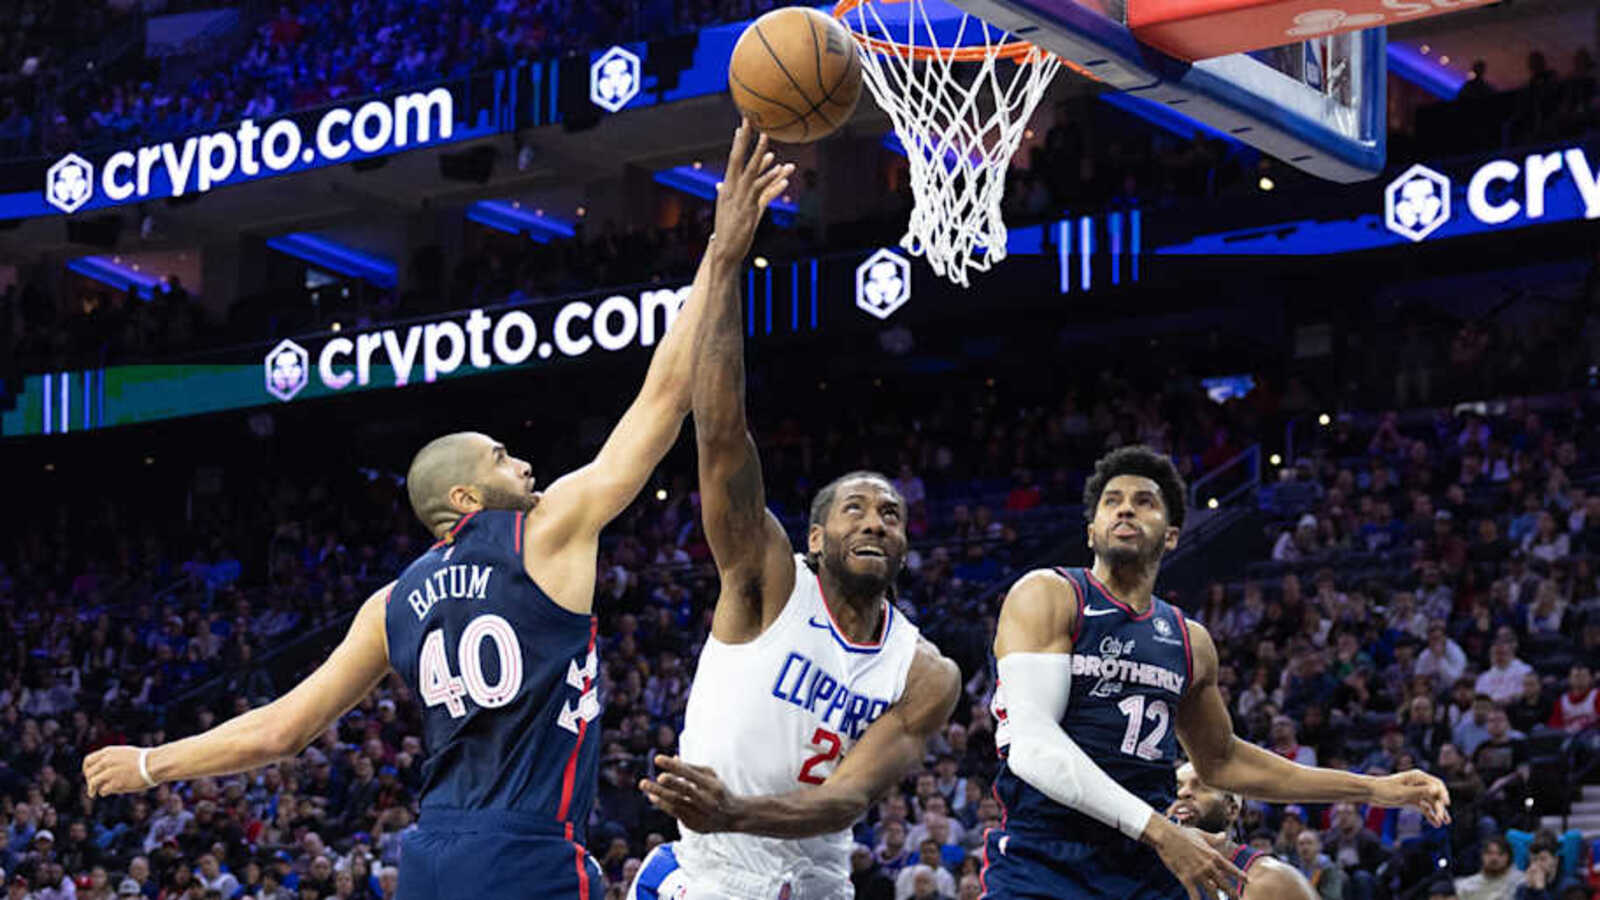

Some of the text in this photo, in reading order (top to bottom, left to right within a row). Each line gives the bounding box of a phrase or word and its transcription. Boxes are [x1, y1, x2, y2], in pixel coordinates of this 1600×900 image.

[101, 87, 453, 200] crypto.com
[408, 564, 493, 621] BATUM
[419, 613, 523, 719] 40
[1072, 654, 1184, 694] BROTHERLY
[798, 727, 842, 786] 2
[1117, 695, 1169, 760] 12
